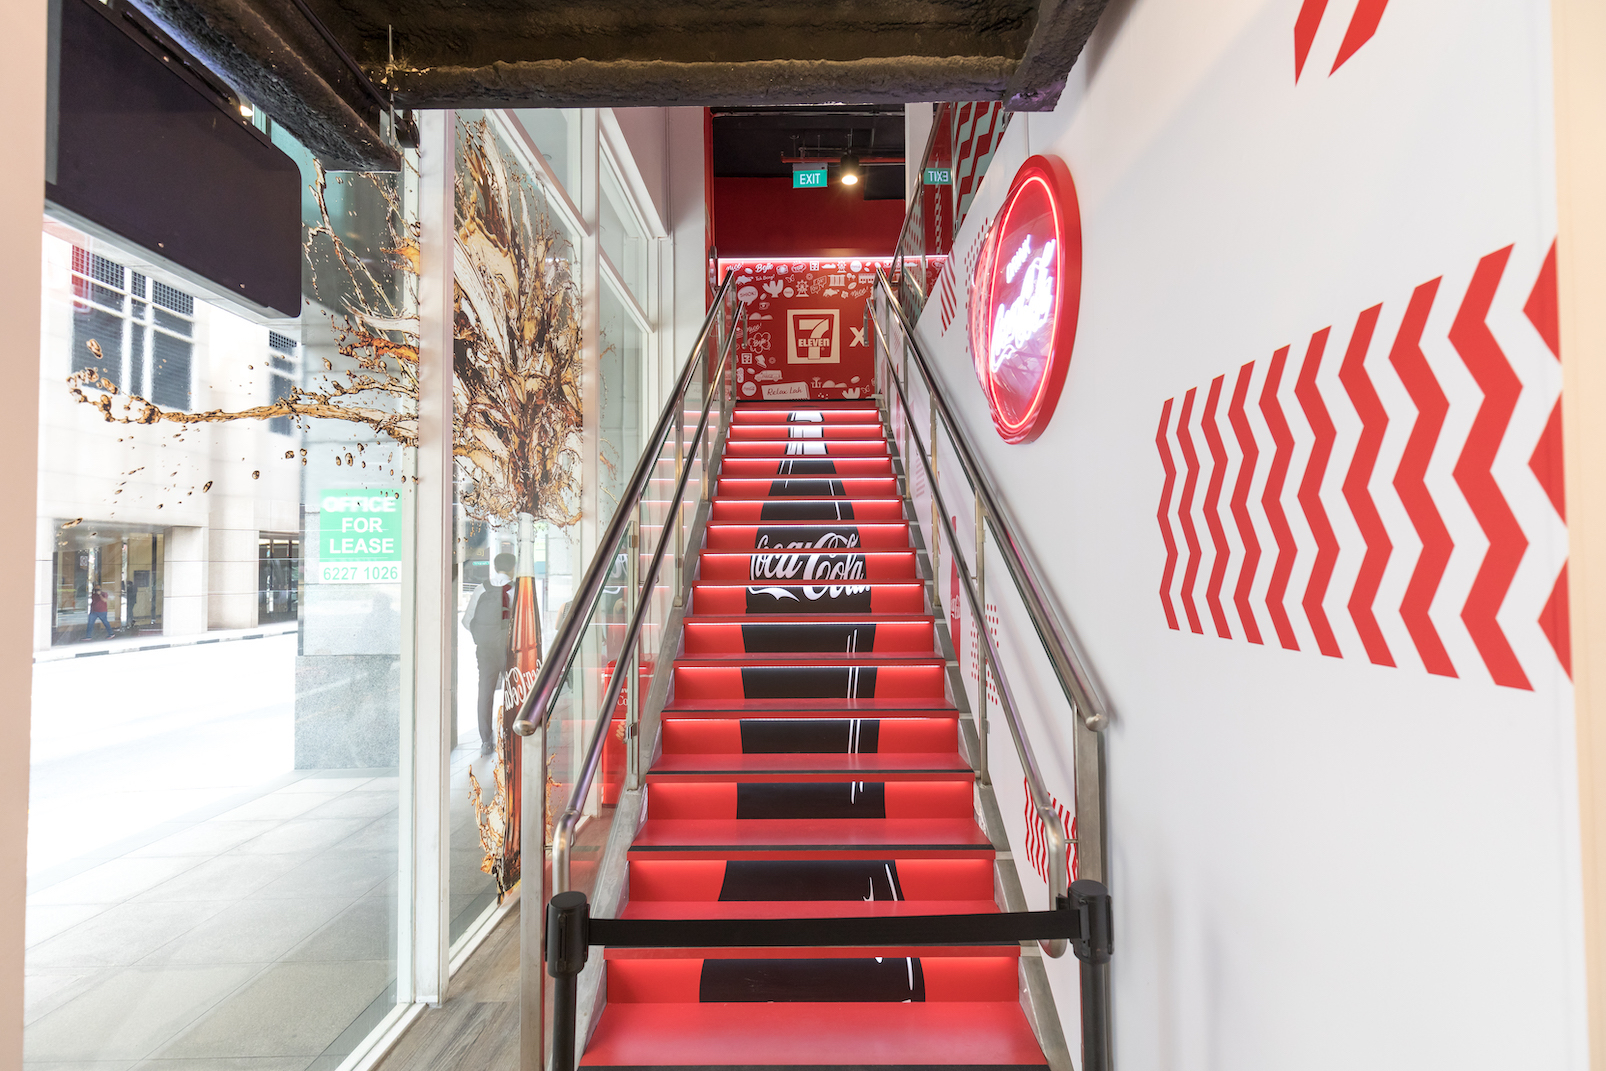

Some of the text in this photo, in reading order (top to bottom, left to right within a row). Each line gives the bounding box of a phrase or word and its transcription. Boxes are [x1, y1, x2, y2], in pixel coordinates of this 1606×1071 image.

[800, 173, 821, 185] EXIT
[766, 387, 788, 396] Relax
[323, 495, 397, 513] OFFICE
[341, 517, 383, 533] FOR
[329, 538, 395, 554] LEASE
[323, 566, 398, 581] 6227 1026
